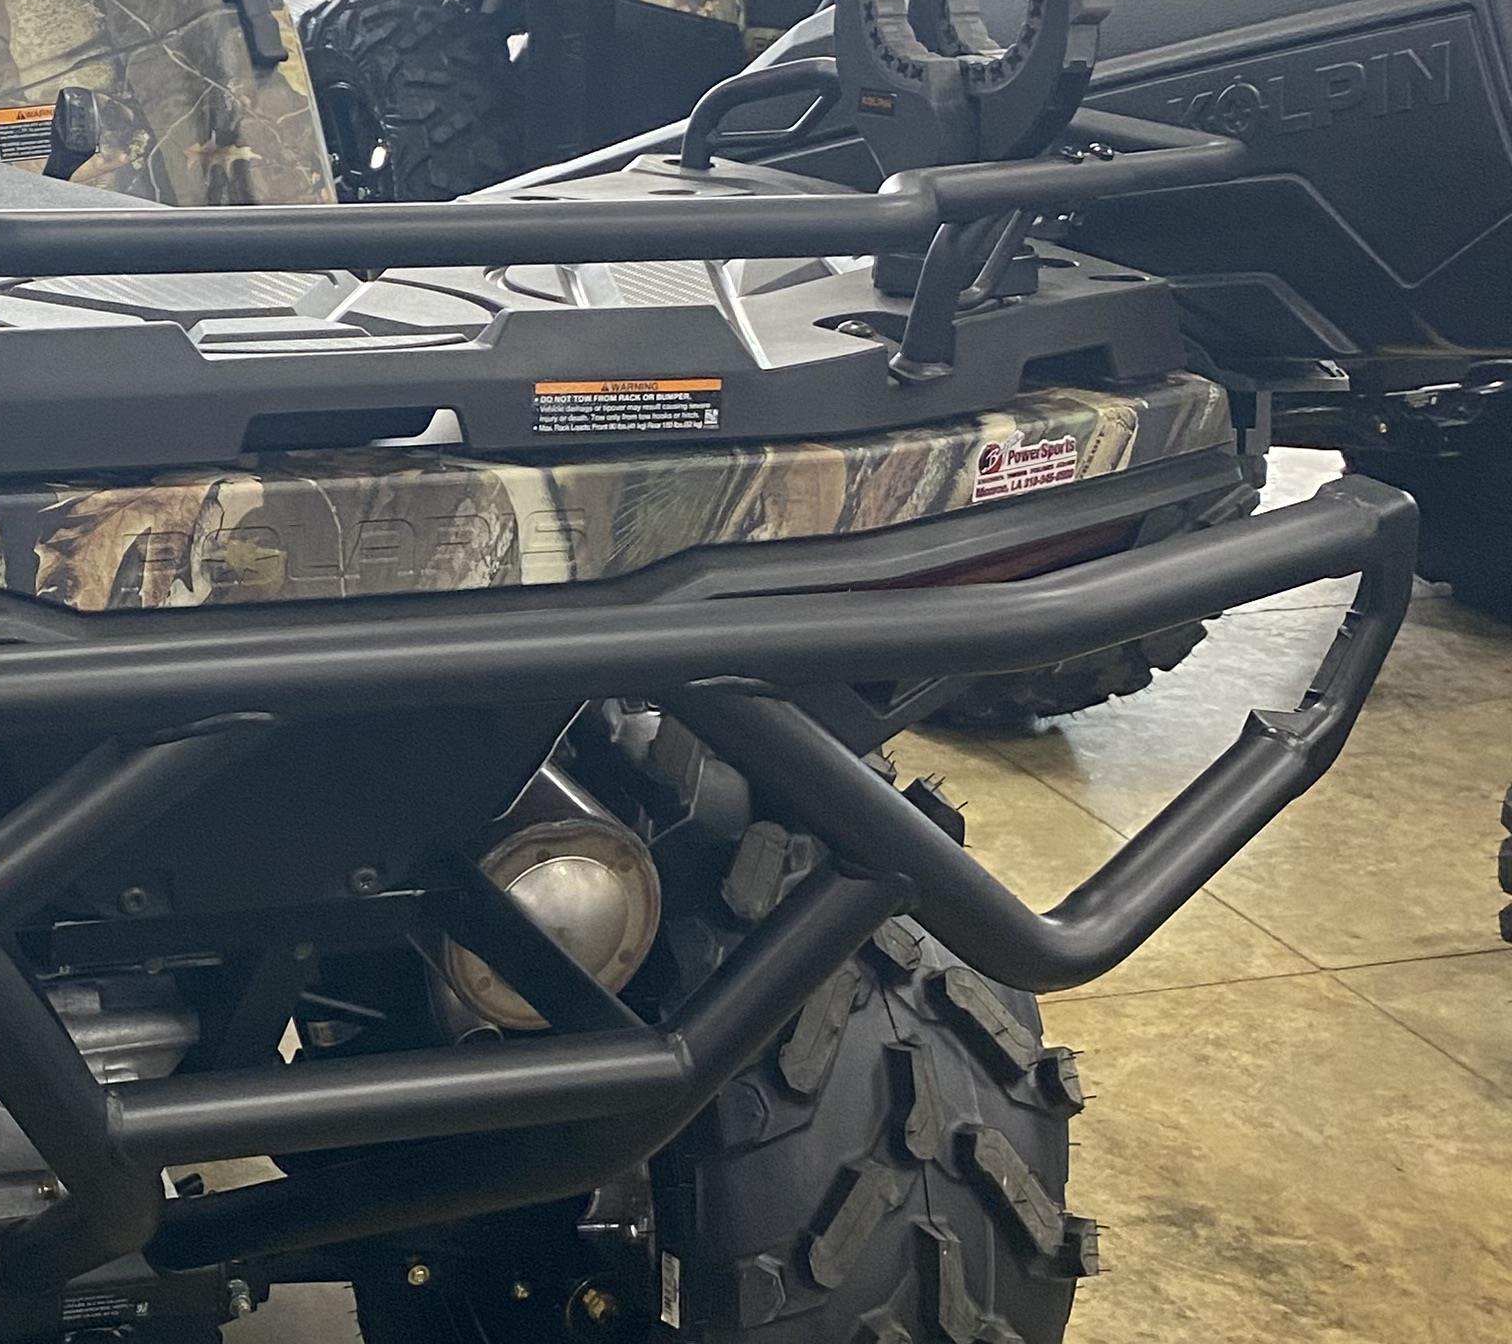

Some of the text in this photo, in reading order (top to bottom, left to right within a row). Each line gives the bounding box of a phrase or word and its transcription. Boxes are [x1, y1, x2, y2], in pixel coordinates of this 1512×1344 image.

[611, 382, 658, 392] WARNING
[540, 393, 692, 404] DO NOT TOW FROM RACK OR BUMPER.
[1007, 438, 1075, 466] PowerSports
[1010, 479, 1023, 492] LA
[120, 508, 587, 593] POLARIS
